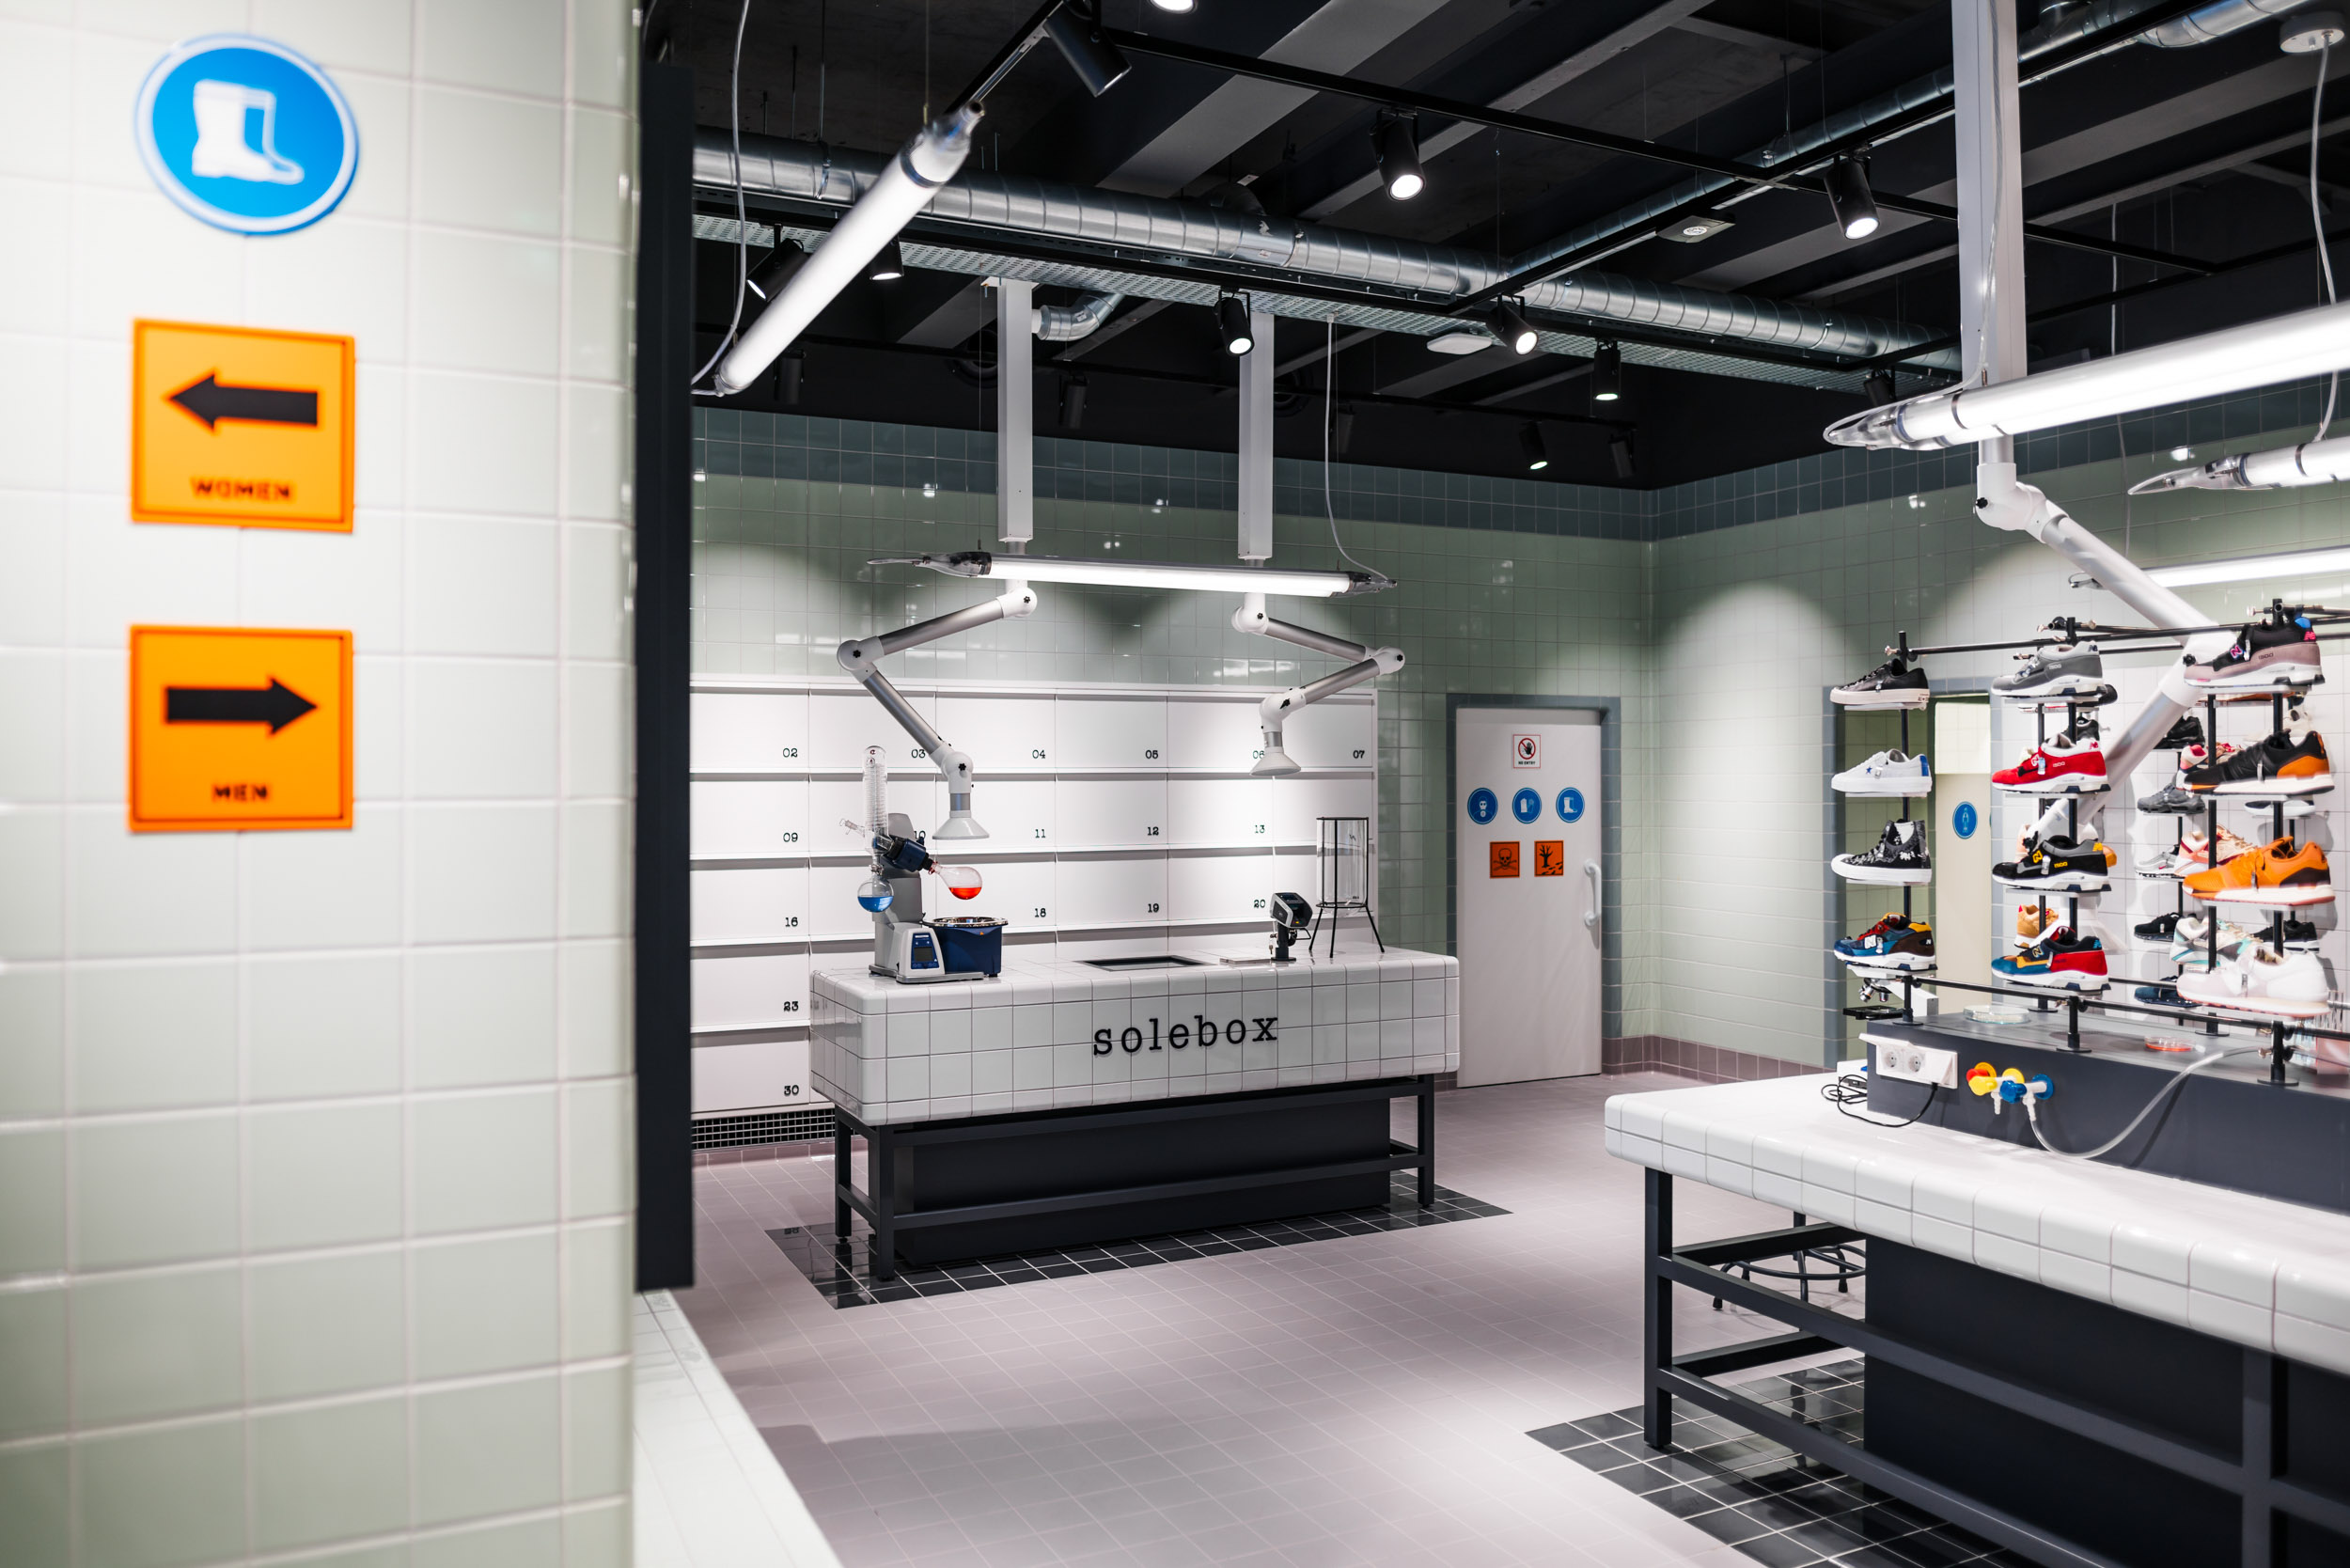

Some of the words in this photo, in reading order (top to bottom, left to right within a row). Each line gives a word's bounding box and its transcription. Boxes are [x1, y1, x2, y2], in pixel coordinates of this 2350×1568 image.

[192, 478, 293, 501] WOMEN
[782, 747, 798, 759] 02
[911, 748, 926, 759] 03
[1031, 749, 1046, 760] 04
[1144, 749, 1159, 760] 05
[1352, 749, 1366, 760] 07
[212, 783, 269, 803] MEN
[1034, 828, 1046, 839] 11
[1147, 826, 1160, 837] 12
[1254, 824, 1265, 834] 13
[782, 832, 799, 843] 09
[1147, 902, 1160, 914] 19
[1252, 899, 1266, 909] 20
[1034, 907, 1047, 918] 18
[784, 917, 799, 928] 16
[1864, 934, 1877, 949] N
[783, 1000, 799, 1012] 23
[1093, 1014, 1278, 1056] solebox
[783, 1085, 800, 1097] 30
